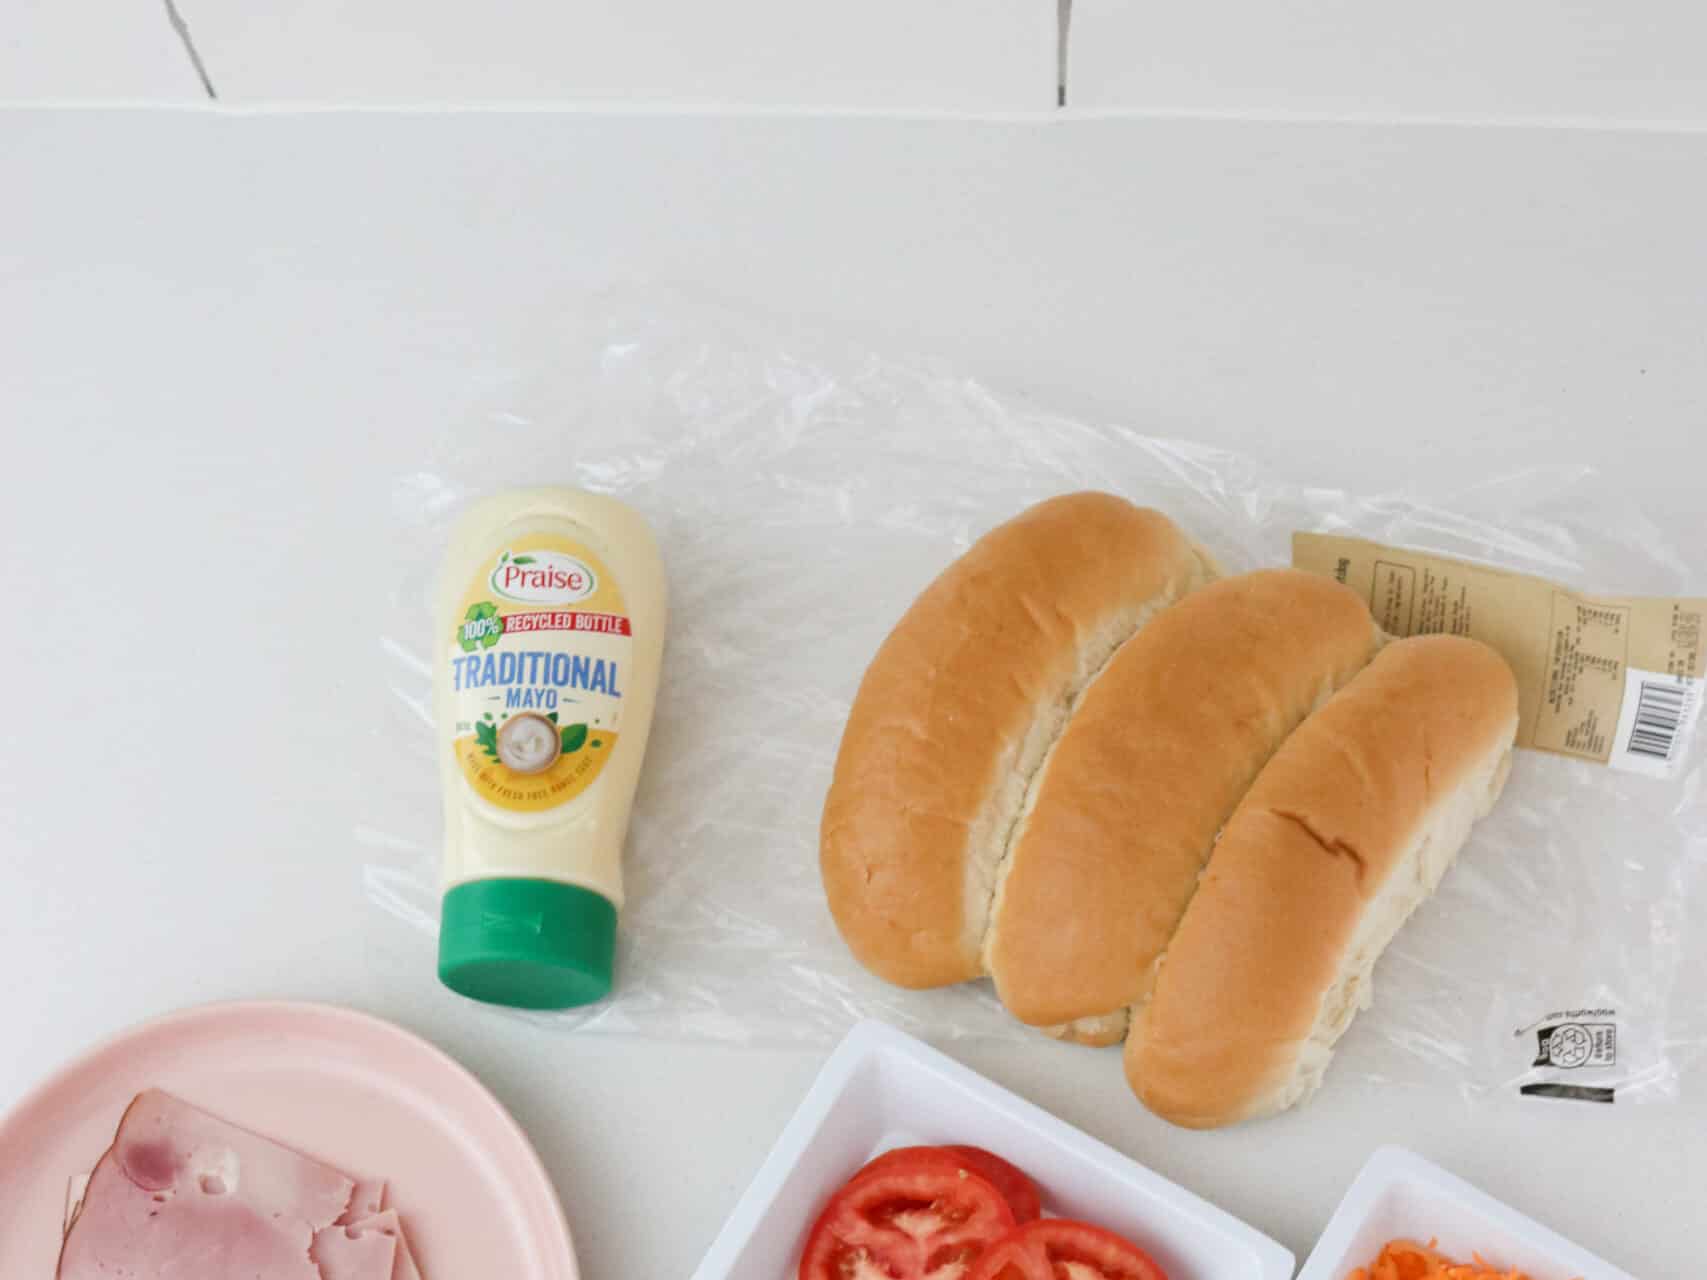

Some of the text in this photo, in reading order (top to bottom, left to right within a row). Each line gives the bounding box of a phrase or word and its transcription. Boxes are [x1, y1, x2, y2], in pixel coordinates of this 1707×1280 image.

[504, 564, 583, 590] Praise
[463, 615, 624, 641] 100% RECYCLED BOTTLE
[452, 652, 622, 698] TRADITIONAL
[506, 688, 558, 709] MAYO
